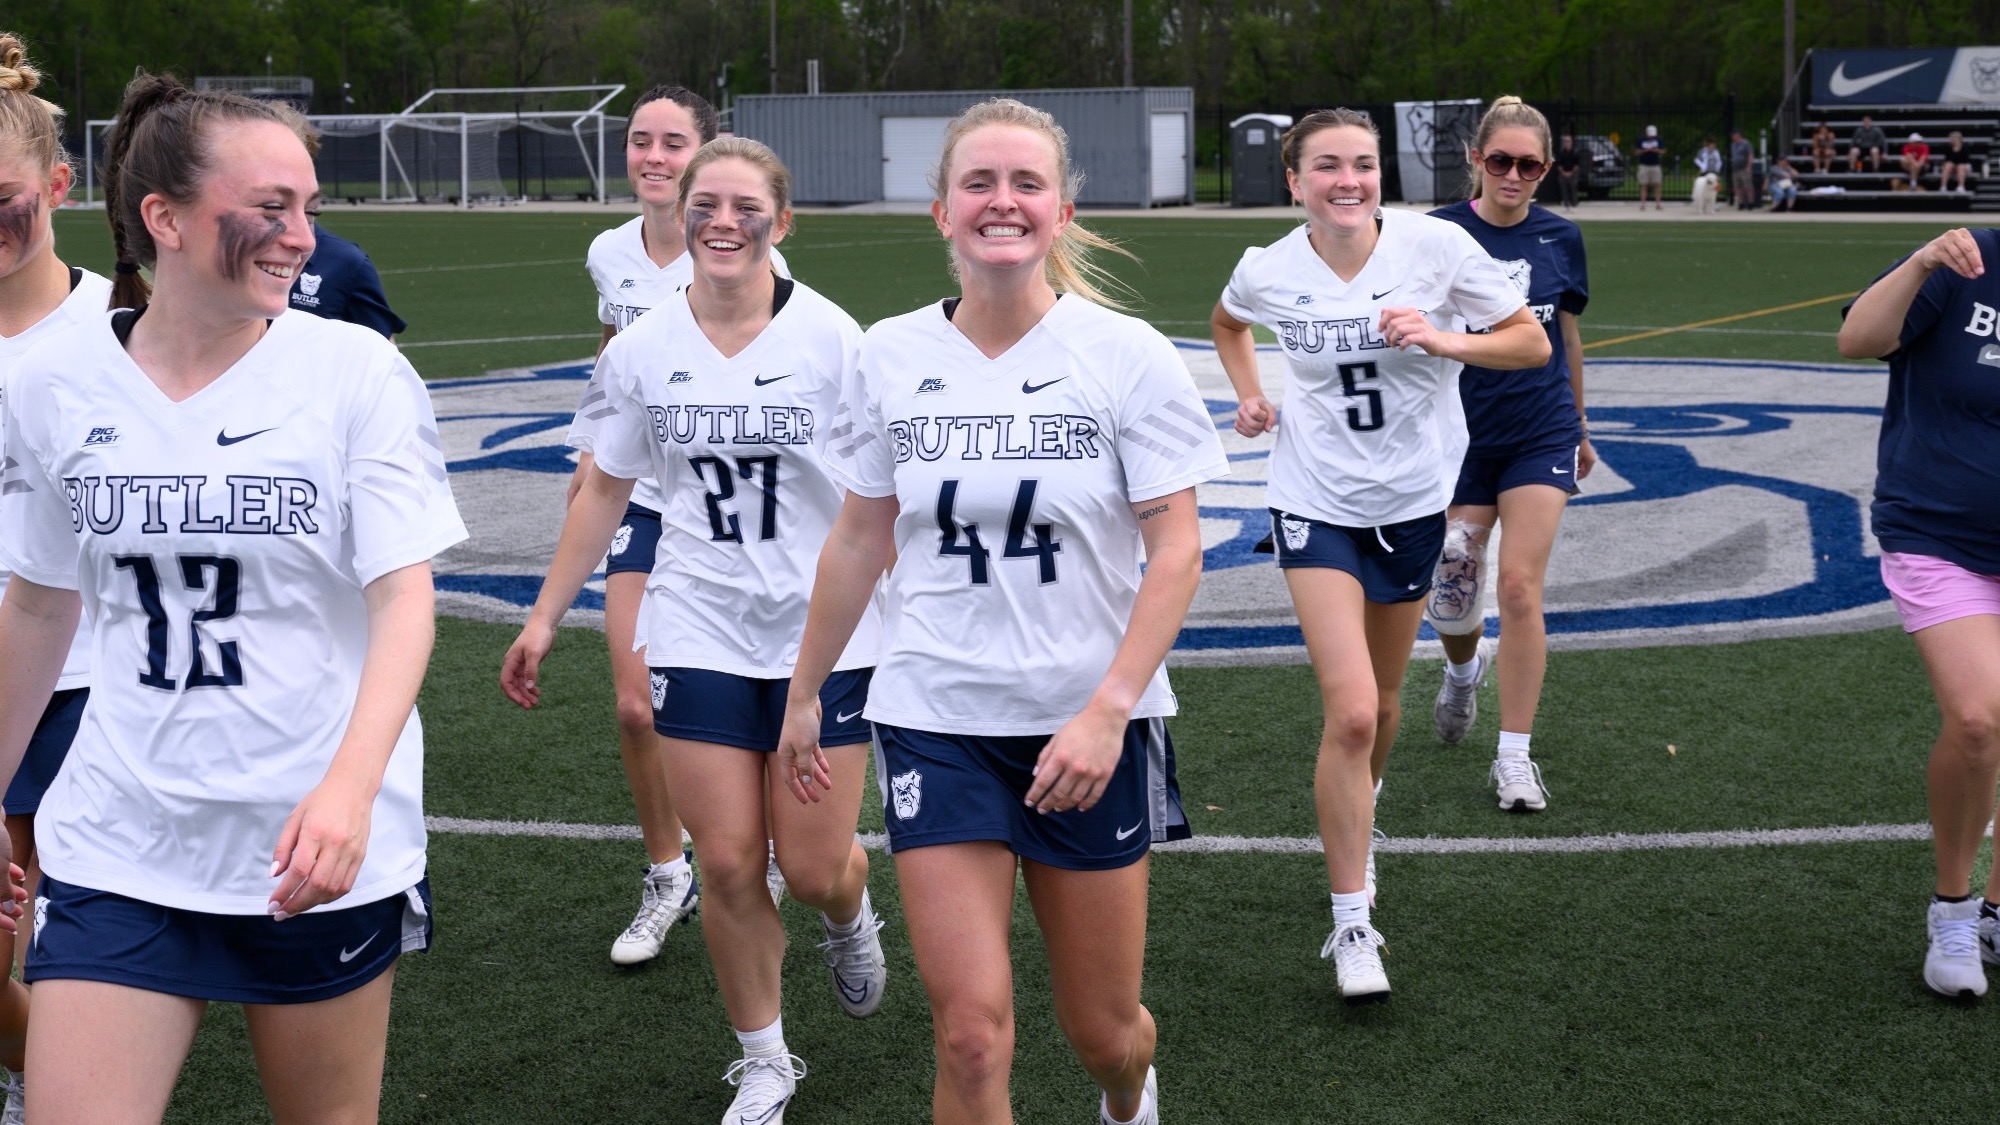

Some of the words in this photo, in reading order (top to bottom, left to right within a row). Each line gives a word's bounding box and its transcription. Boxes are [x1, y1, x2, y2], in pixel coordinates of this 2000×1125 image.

[292, 292, 321, 304] BUTLER
[1277, 316, 1403, 353] BUTL
[1336, 359, 1386, 432] 5
[84, 434, 121, 444] EAST
[89, 427, 116, 436] BIG
[646, 404, 815, 444] BUTLER
[887, 414, 1099, 463] BUTLER
[62, 475, 319, 535] BUTLER
[688, 454, 781, 545] 27
[1137, 503, 1170, 521] REJOICE
[935, 476, 1064, 587] 44
[109, 552, 248, 694] 12
